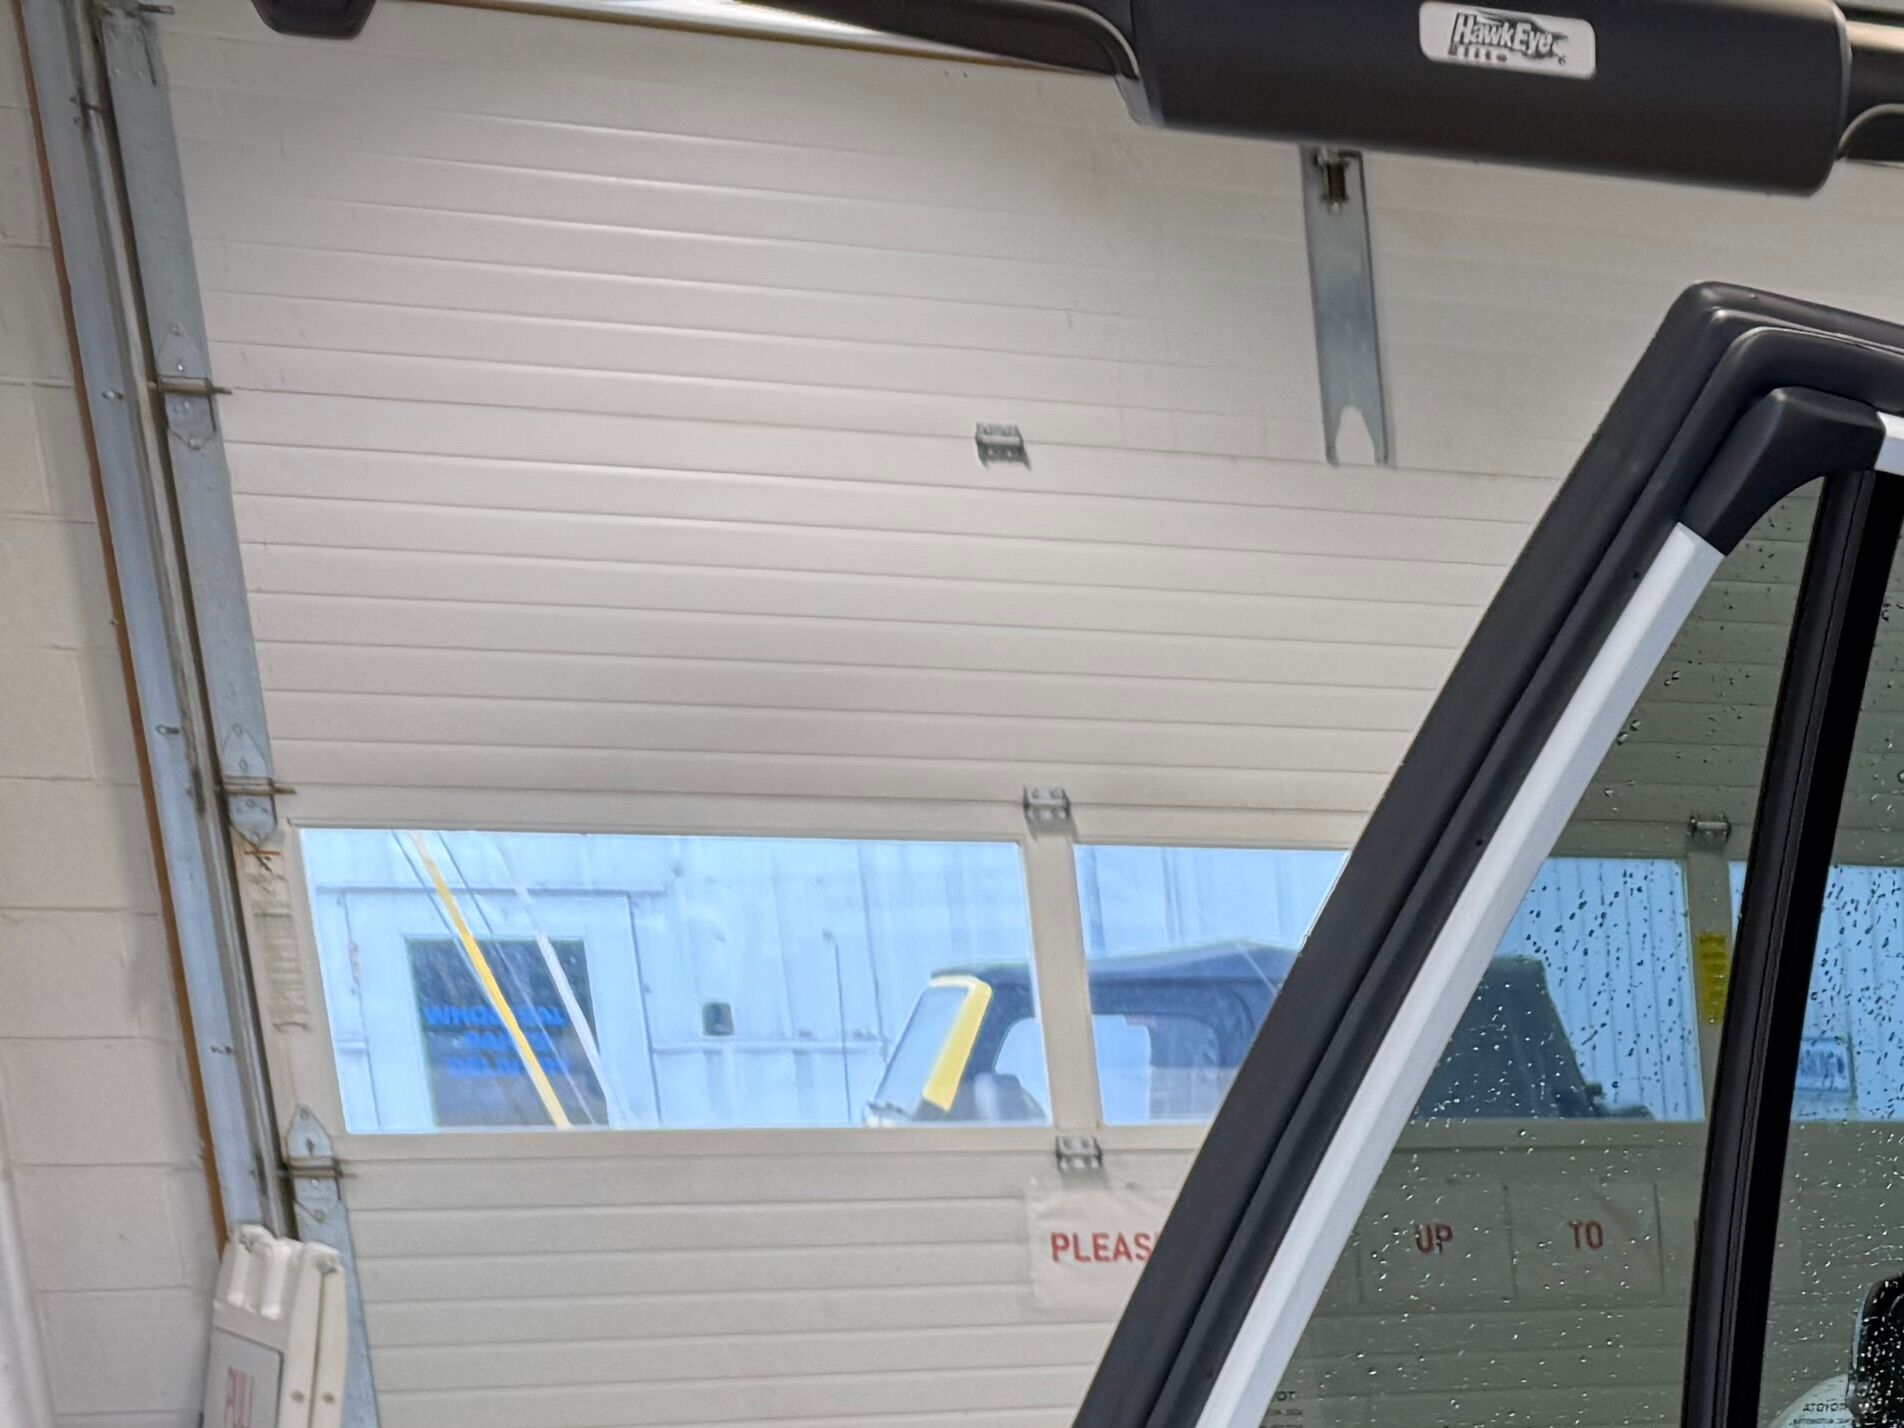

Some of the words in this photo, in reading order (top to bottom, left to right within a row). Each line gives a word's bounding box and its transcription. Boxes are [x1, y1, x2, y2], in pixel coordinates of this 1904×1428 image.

[1450, 12, 1554, 57] HawkEye
[1050, 1230, 1158, 1265] PLEAS
[1416, 1224, 1454, 1255] UP
[1568, 1219, 1604, 1251] TO
